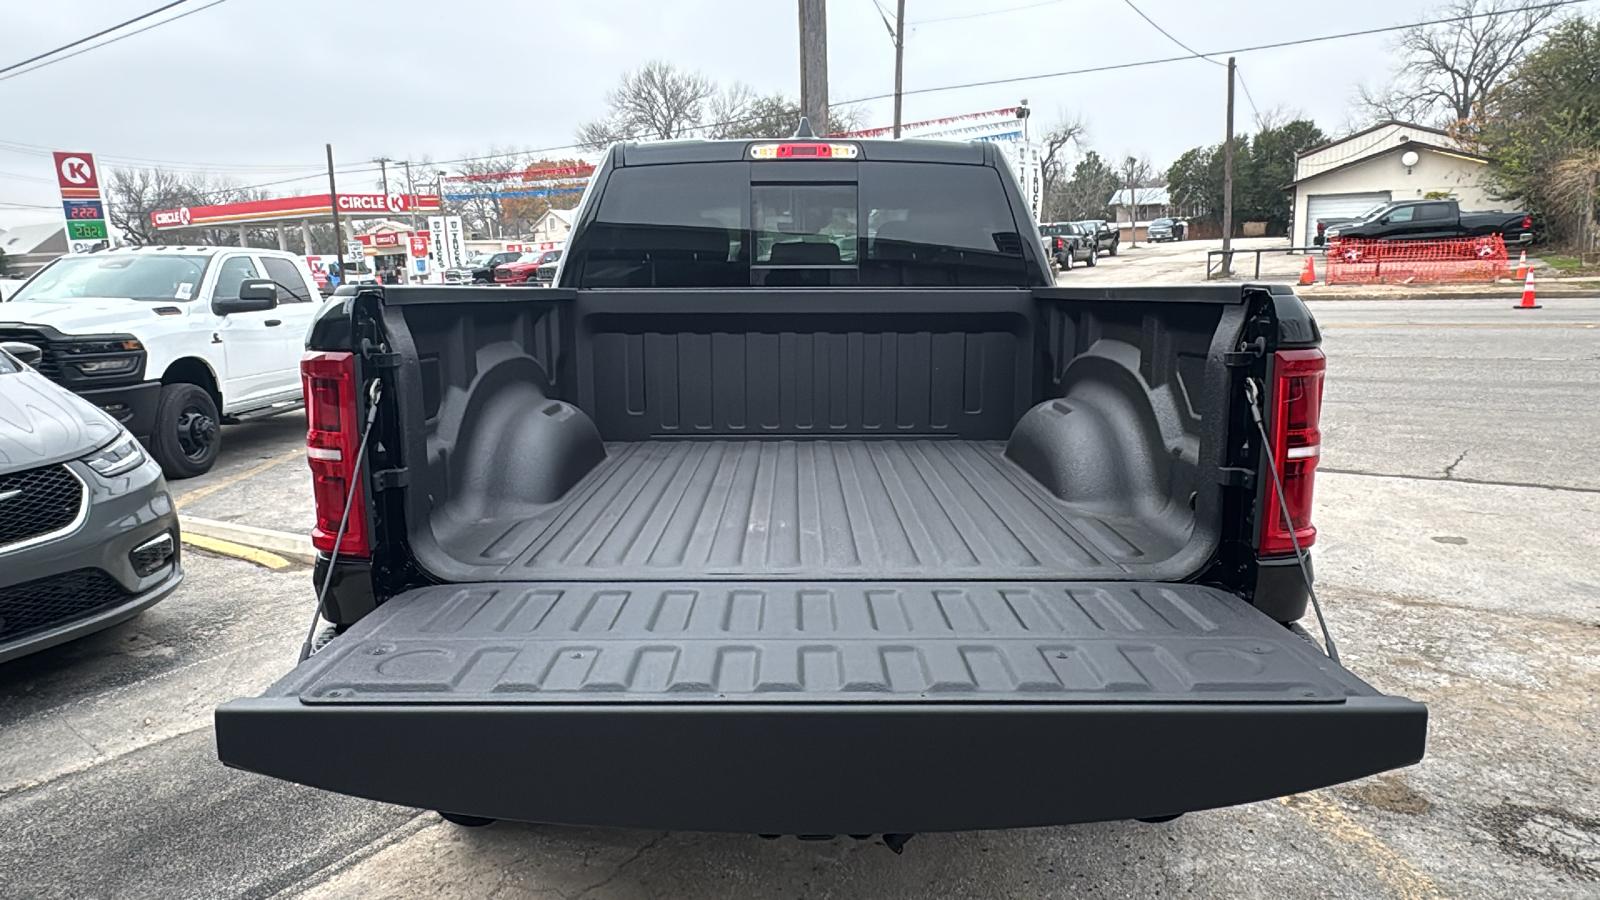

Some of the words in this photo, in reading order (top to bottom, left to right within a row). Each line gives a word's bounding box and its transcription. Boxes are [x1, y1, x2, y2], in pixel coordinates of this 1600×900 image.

[65, 160, 91, 181] K
[339, 196, 385, 209] CIRCLE
[388, 195, 403, 211] K
[155, 212, 180, 224] CIRCLE
[181, 208, 190, 224] K
[351, 251, 363, 260] 35
[435, 234, 445, 268] TRUCKS
[452, 233, 462, 268] TRUCKS
